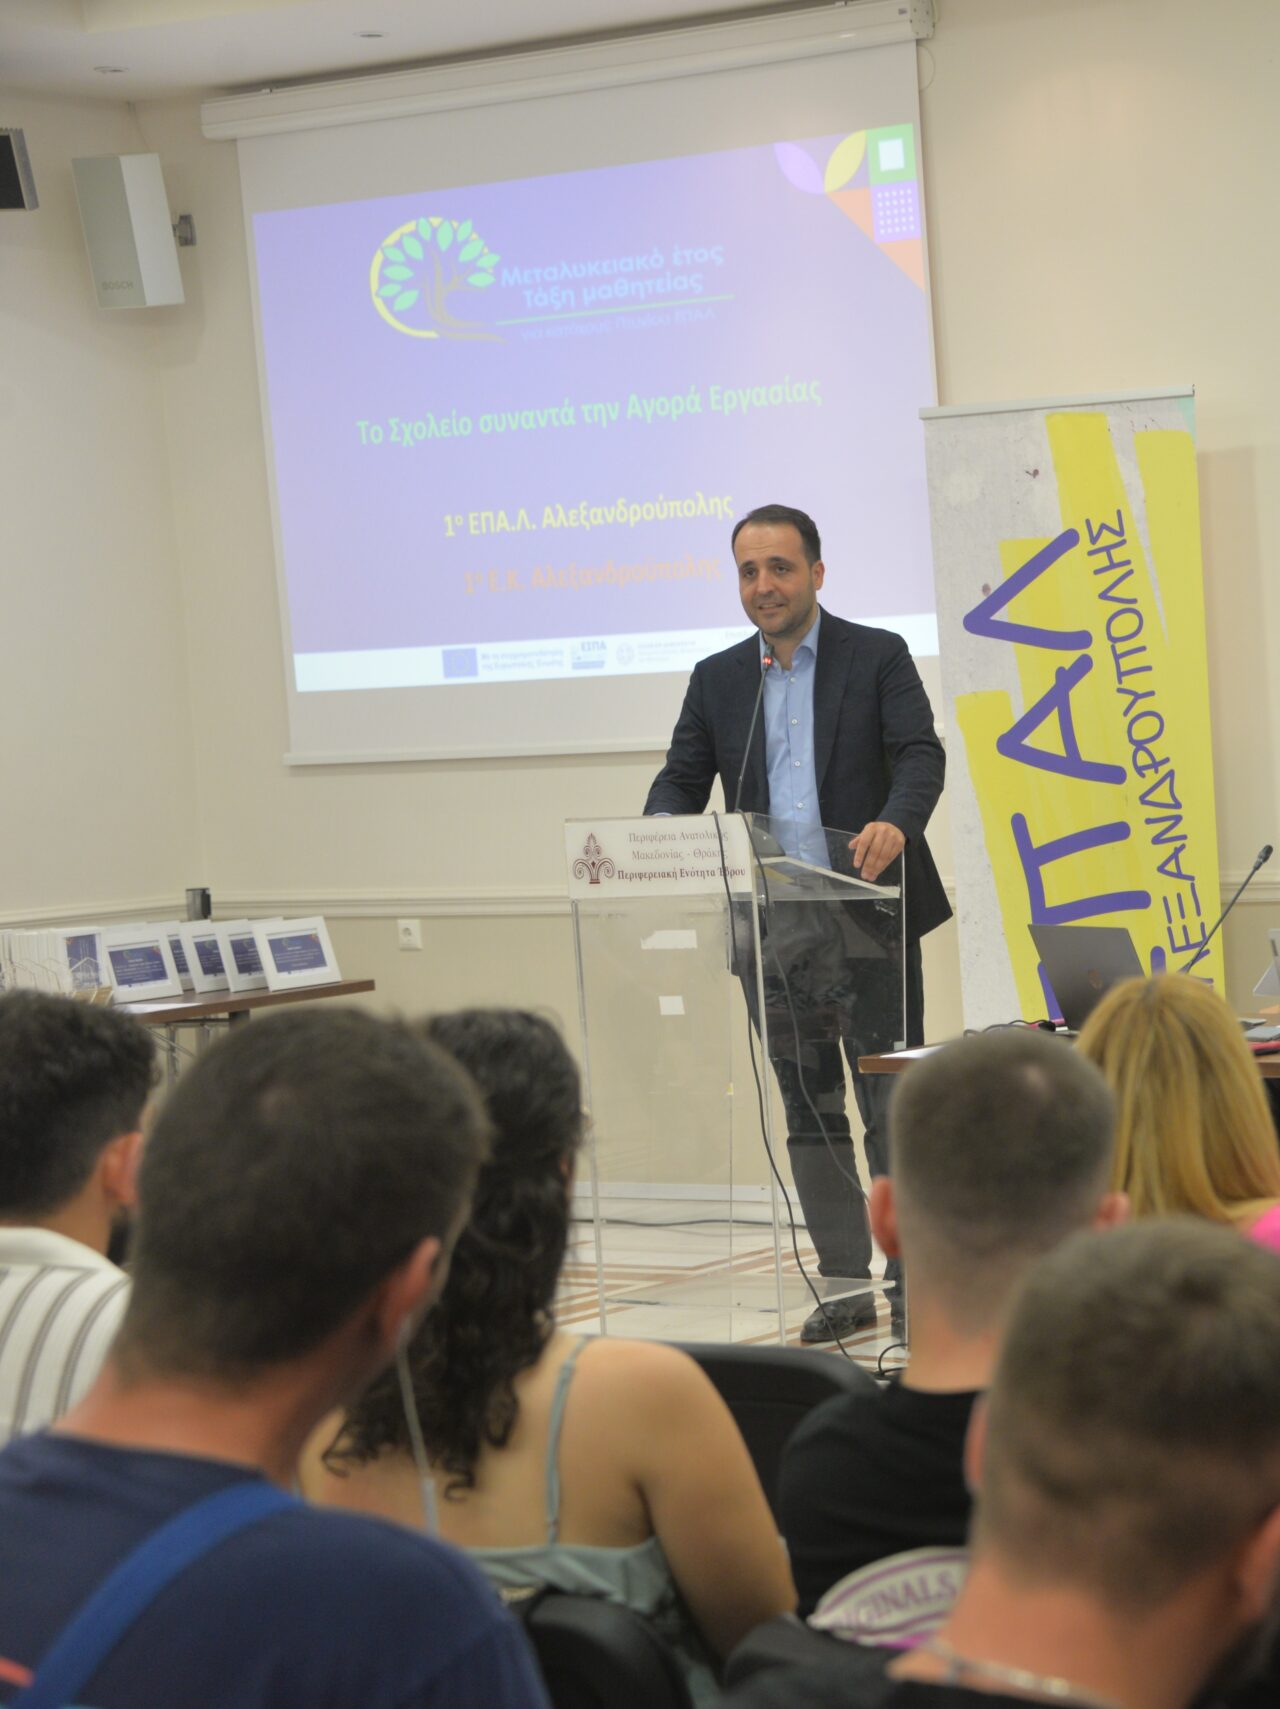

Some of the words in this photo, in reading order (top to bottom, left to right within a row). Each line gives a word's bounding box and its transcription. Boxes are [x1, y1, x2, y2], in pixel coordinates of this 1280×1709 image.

[501, 247, 665, 287] Μεταλυκειακό
[672, 245, 725, 267] έτος
[102, 281, 134, 291] BOSCH
[582, 271, 705, 306] μαθητείας
[356, 420, 383, 445] Το
[388, 407, 473, 447] Σχολείο
[479, 397, 576, 433] συναντά
[581, 400, 621, 428] την
[626, 384, 703, 424] Αγορά
[709, 374, 823, 416] Εργασίας
[468, 508, 537, 535] ΕΠΑ.Λ.
[541, 491, 734, 531] Αλεξανδρούπολης
[962, 527, 1165, 1021] ΠΑΛ
[628, 831, 677, 845] Περιφέρεια
[632, 848, 684, 861] Μακεδονίας
[617, 866, 678, 882] Περιφερειακή
[680, 866, 716, 879] Ενότητα
